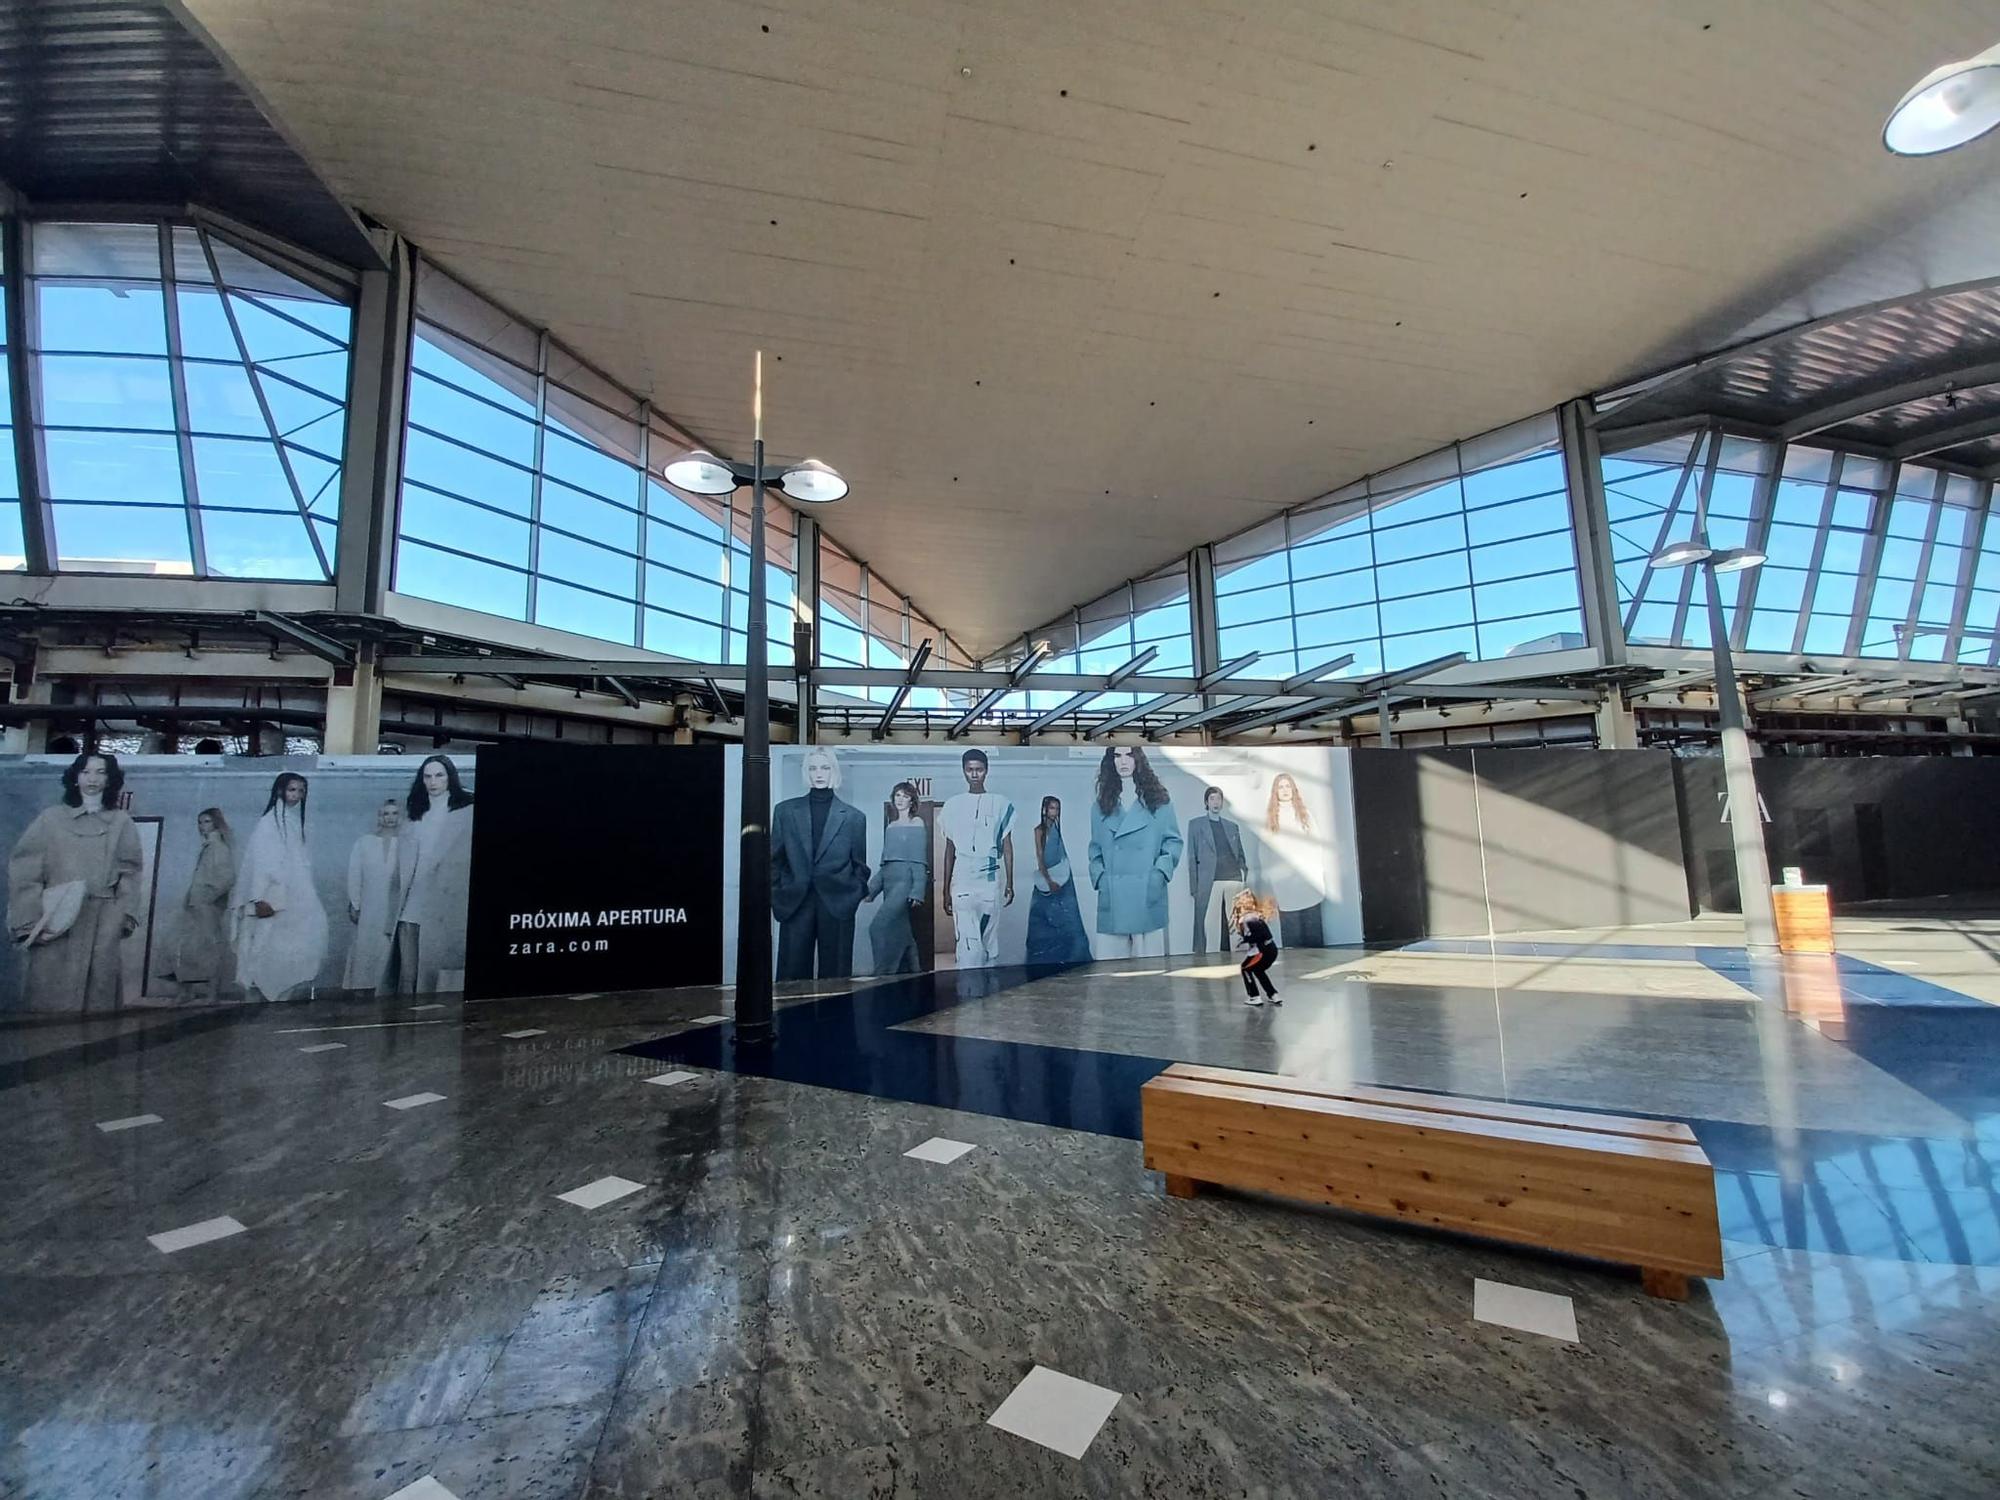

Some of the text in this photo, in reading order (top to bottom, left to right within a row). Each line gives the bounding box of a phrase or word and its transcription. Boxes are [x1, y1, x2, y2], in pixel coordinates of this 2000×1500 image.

[509, 907, 688, 930] PRÓXIMA APERTURA
[509, 939, 609, 955] zara.com
